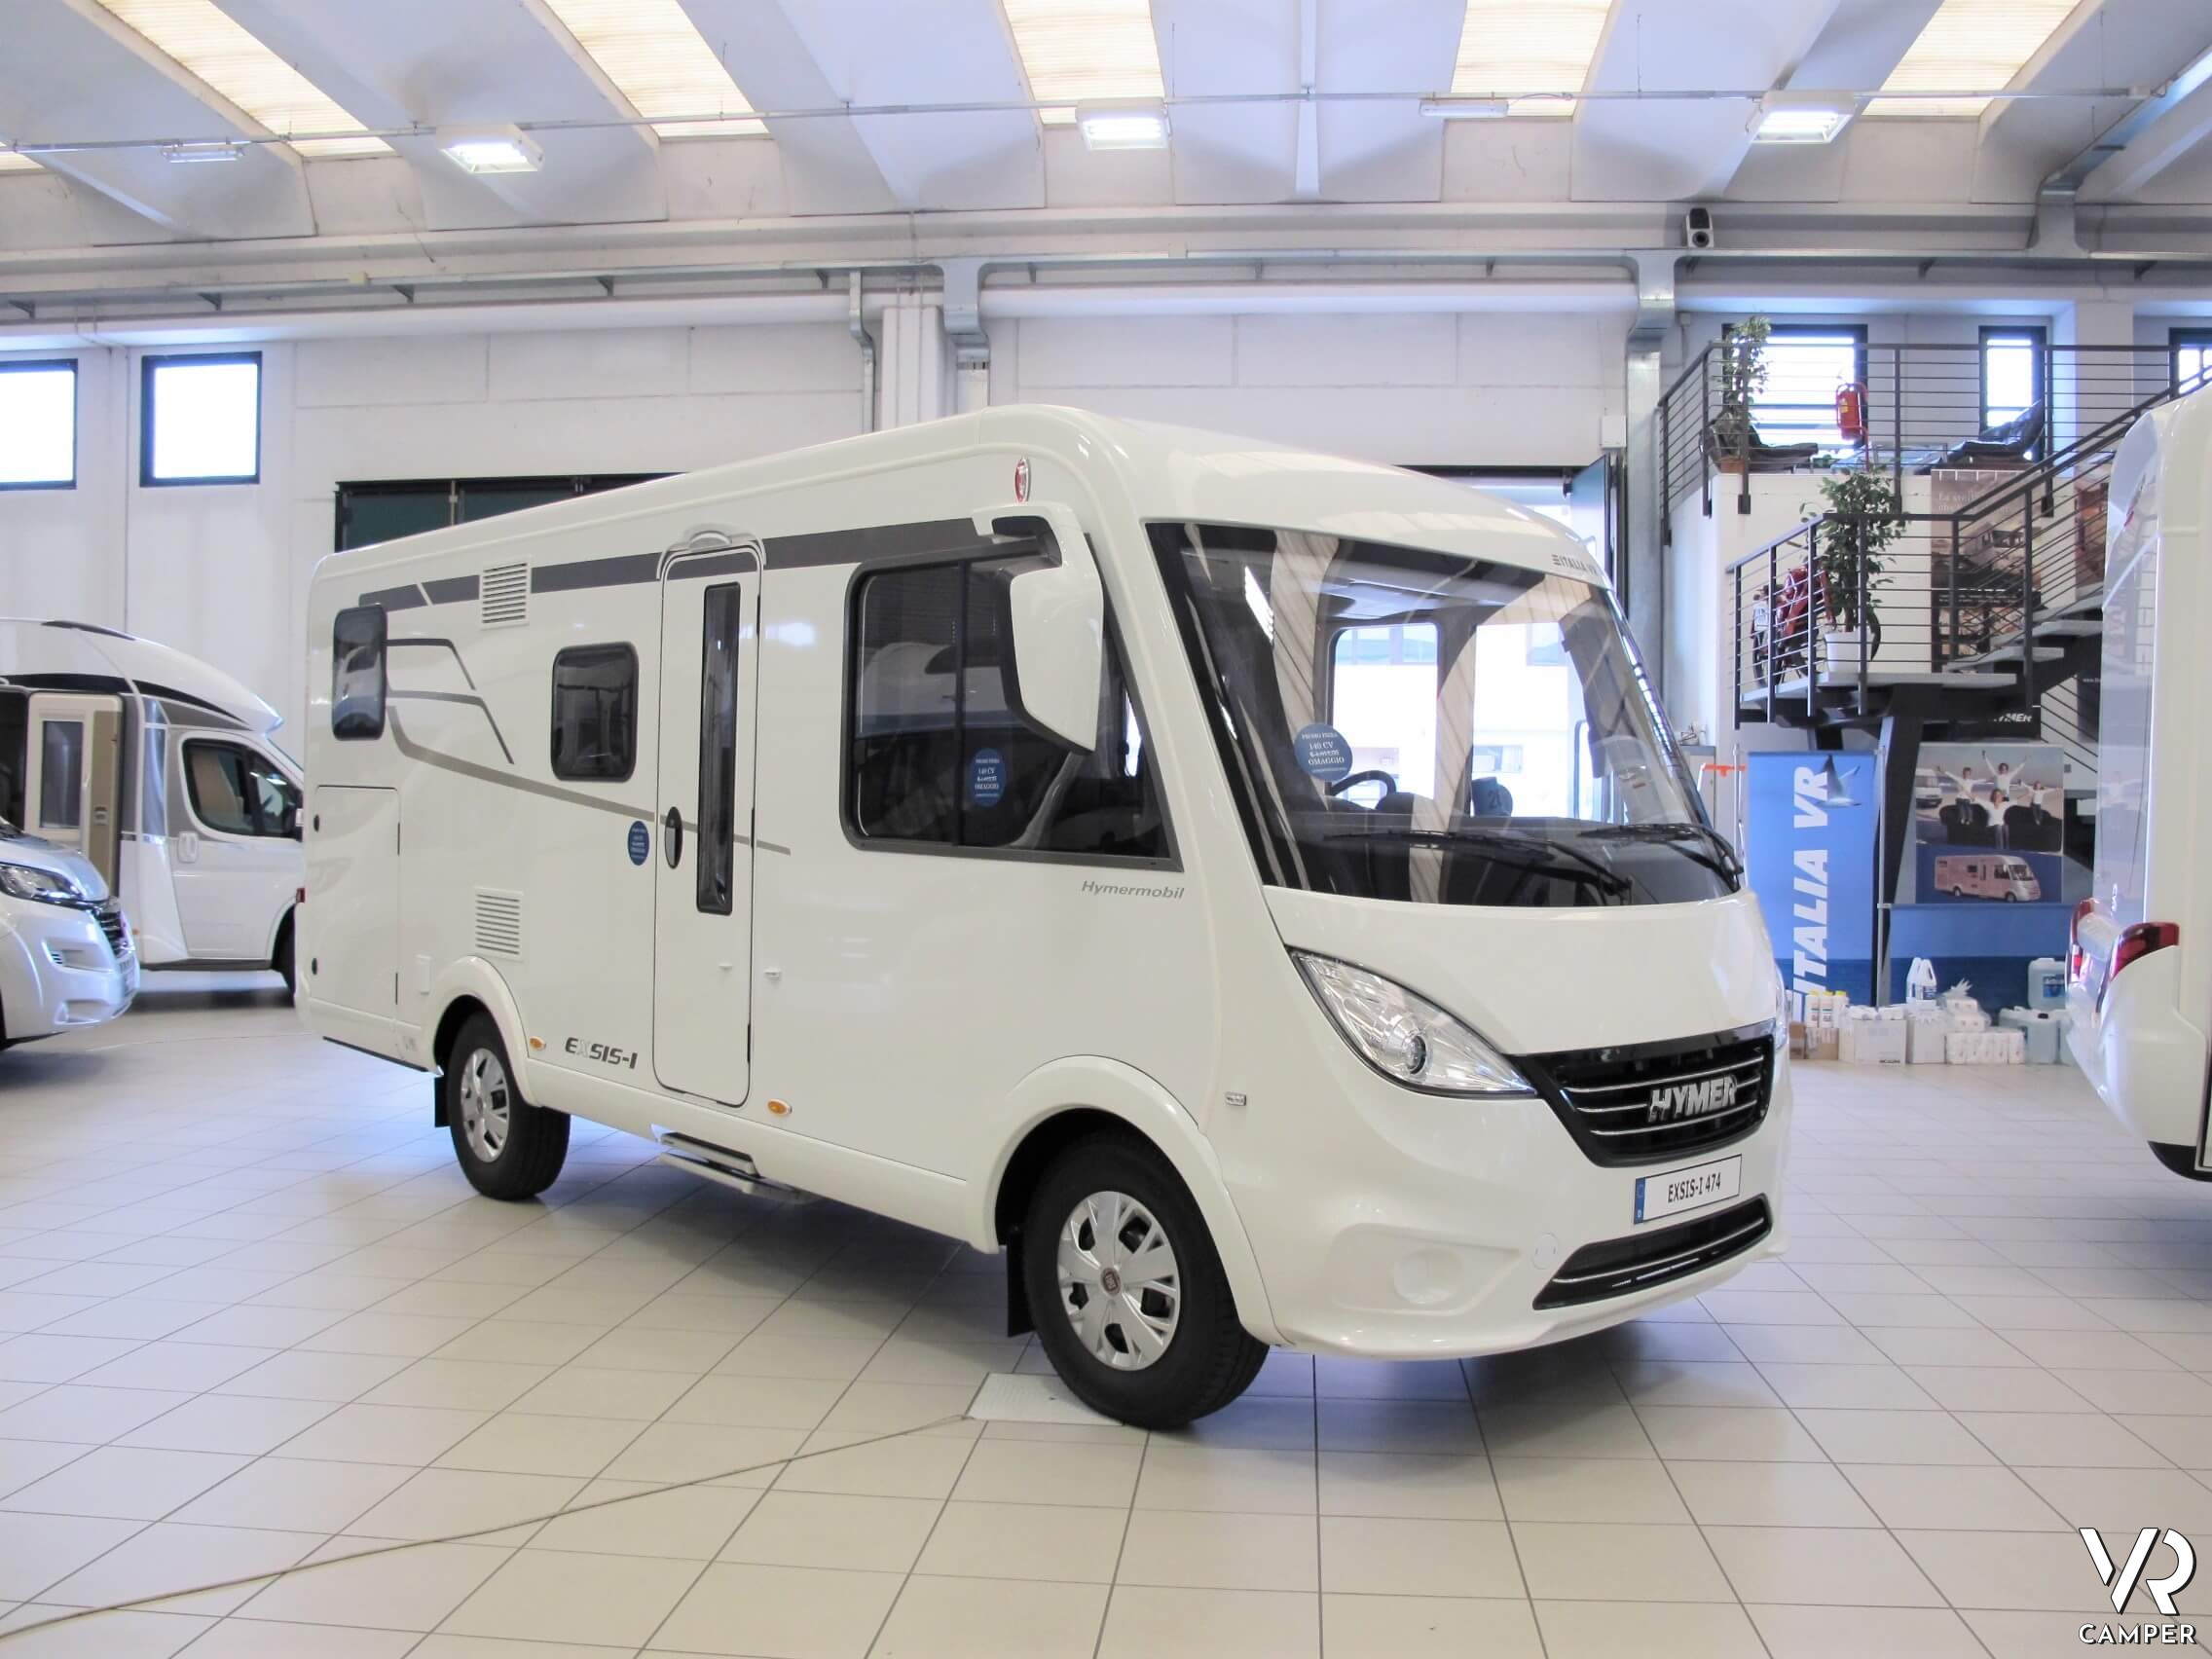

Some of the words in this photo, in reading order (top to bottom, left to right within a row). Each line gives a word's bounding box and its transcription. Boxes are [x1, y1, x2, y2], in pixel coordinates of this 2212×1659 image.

[1793, 766, 1828, 829] VR
[1082, 880, 1185, 900] Hymermobil
[565, 1037, 638, 1070] EXSIS-I
[1647, 1074, 1738, 1123] HYMER
[1667, 1176, 1704, 1203] EXSIS-I
[1705, 1171, 1721, 1194] 474
